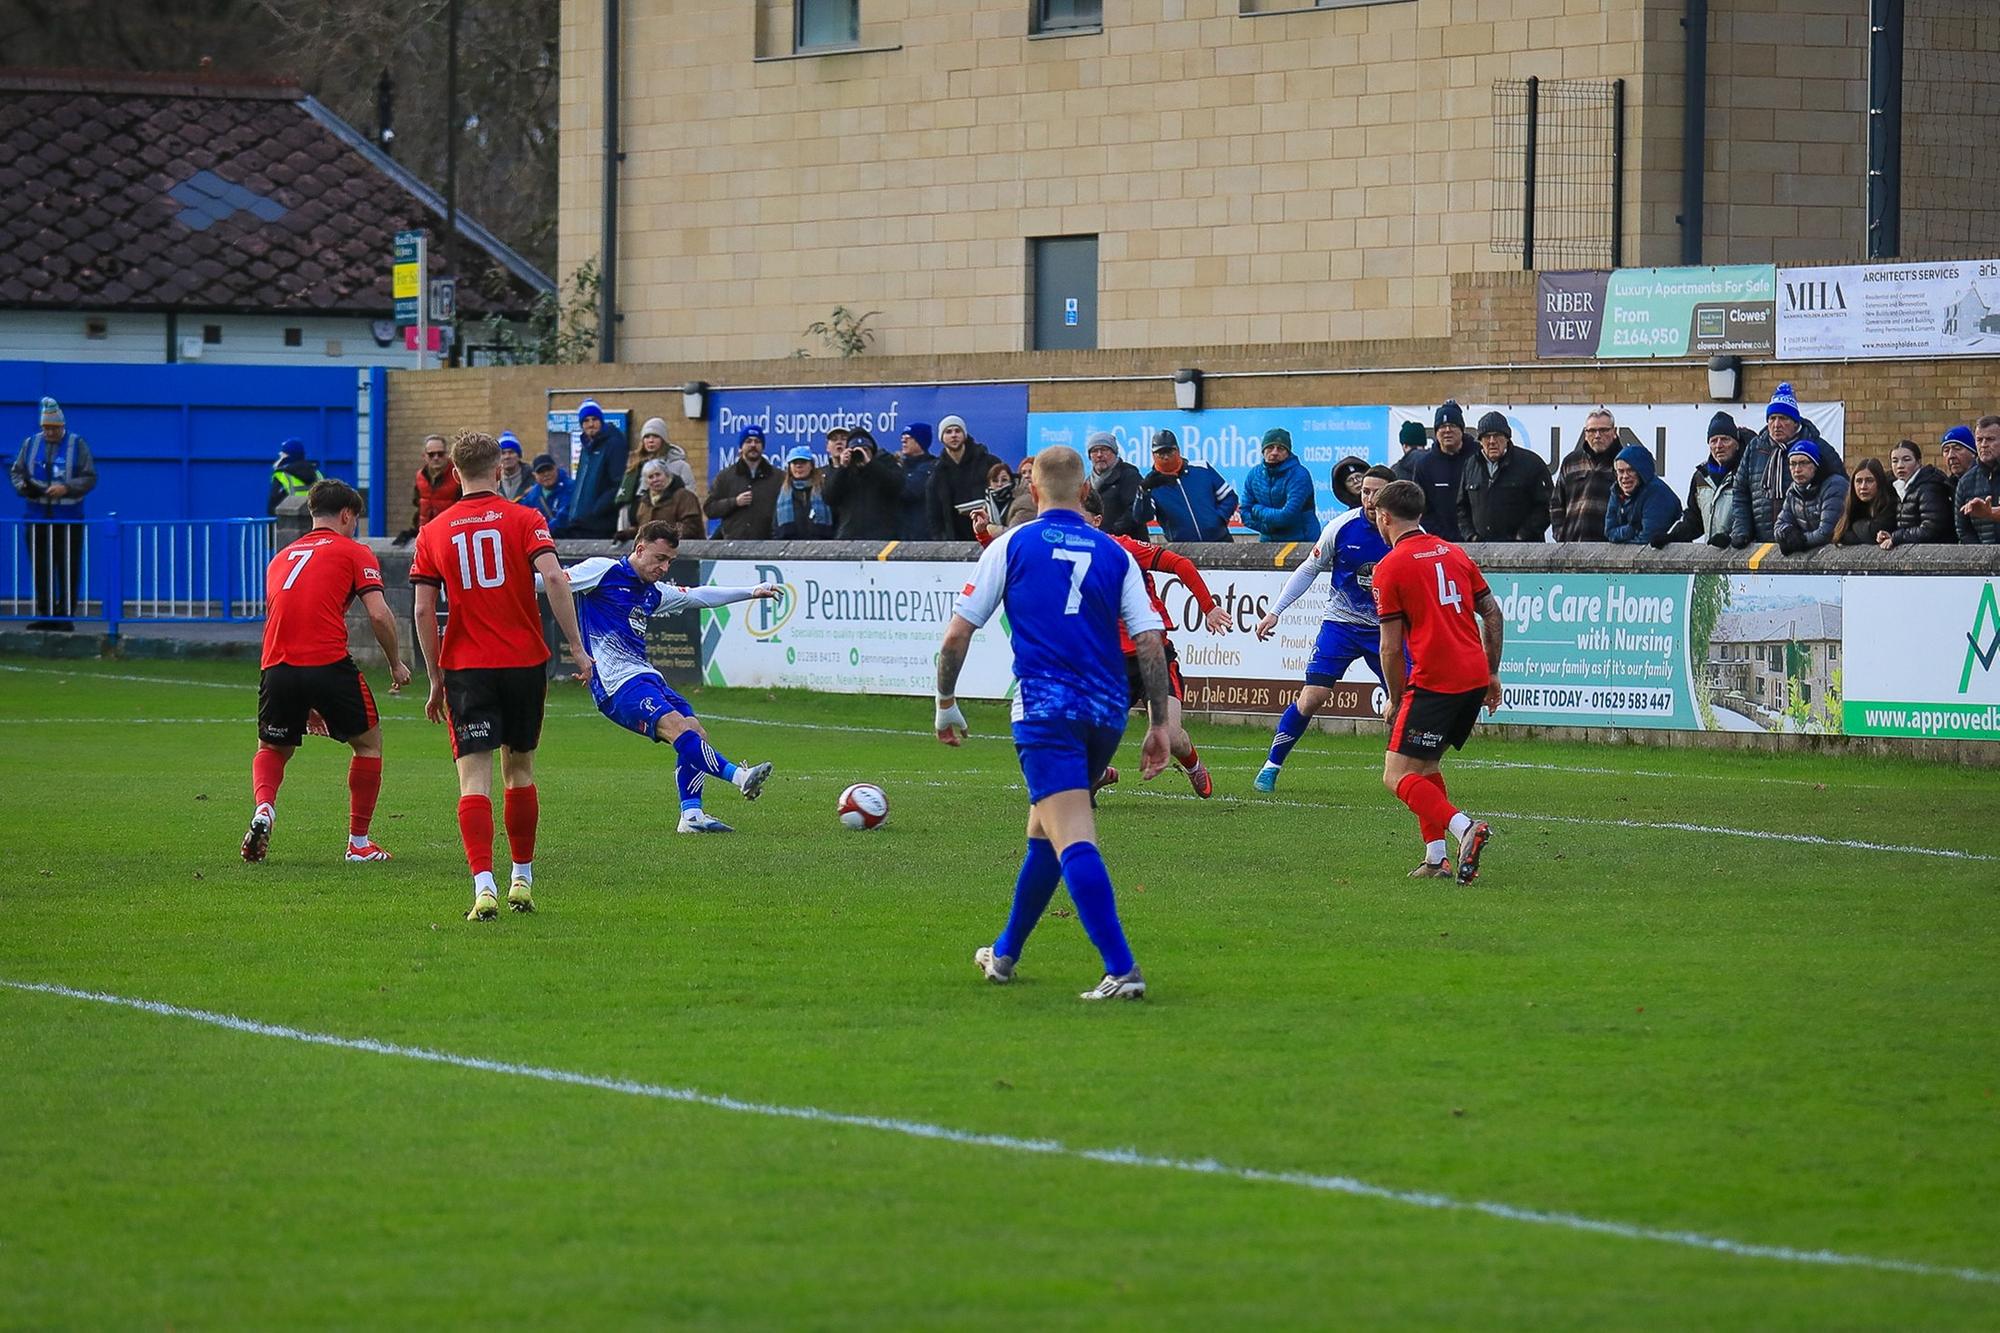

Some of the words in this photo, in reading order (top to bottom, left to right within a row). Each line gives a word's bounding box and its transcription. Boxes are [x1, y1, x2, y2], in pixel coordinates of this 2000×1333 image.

[1862, 270, 1917, 282] ARCHITECT'S
[1918, 268, 1960, 280] SERVICES
[1615, 282, 1652, 298] Luxury
[1655, 280, 1722, 298] Apartments
[1725, 281, 1743, 293] For
[1746, 278, 1769, 292] Sale
[1784, 281, 1847, 311] MHA
[1614, 307, 1650, 323] From
[1730, 308, 1766, 322] Clowes
[1613, 328, 1679, 346] £164,950
[719, 405, 771, 434] Proud
[774, 406, 873, 442] supporters
[878, 401, 899, 433] of
[1182, 424, 1262, 468] Botha
[281, 549, 314, 591] 7
[451, 528, 505, 590] 10
[1052, 548, 1092, 615] 7
[1434, 562, 1462, 614] 4
[1547, 584, 1601, 623] Care
[1606, 585, 1674, 624] Home
[1281, 634, 1306, 649] Proud
[1577, 626, 1610, 651] with
[1614, 628, 1672, 659] Nursing
[1186, 643, 1241, 666] Butchers
[1281, 656, 1306, 671] Matlo
[1540, 661, 1561, 677] your
[1561, 657, 1591, 679] family
[1591, 663, 1601, 674] as
[1601, 659, 1612, 679] if
[1612, 660, 1626, 675] it's
[1627, 664, 1643, 675] our
[1643, 660, 1673, 681] family
[1184, 685, 1199, 708] ley
[1202, 685, 1226, 704] Dale
[1228, 686, 1249, 704] DE4
[1251, 687, 1269, 705] 2FS
[1278, 689, 1299, 706] 016
[1337, 690, 1358, 708] 639
[1502, 688, 1540, 709] QUIRE
[1542, 689, 1583, 708] TODAY
[1591, 691, 1625, 710] 01629
[1628, 692, 1648, 710] 583
[1650, 693, 1671, 710] 447
